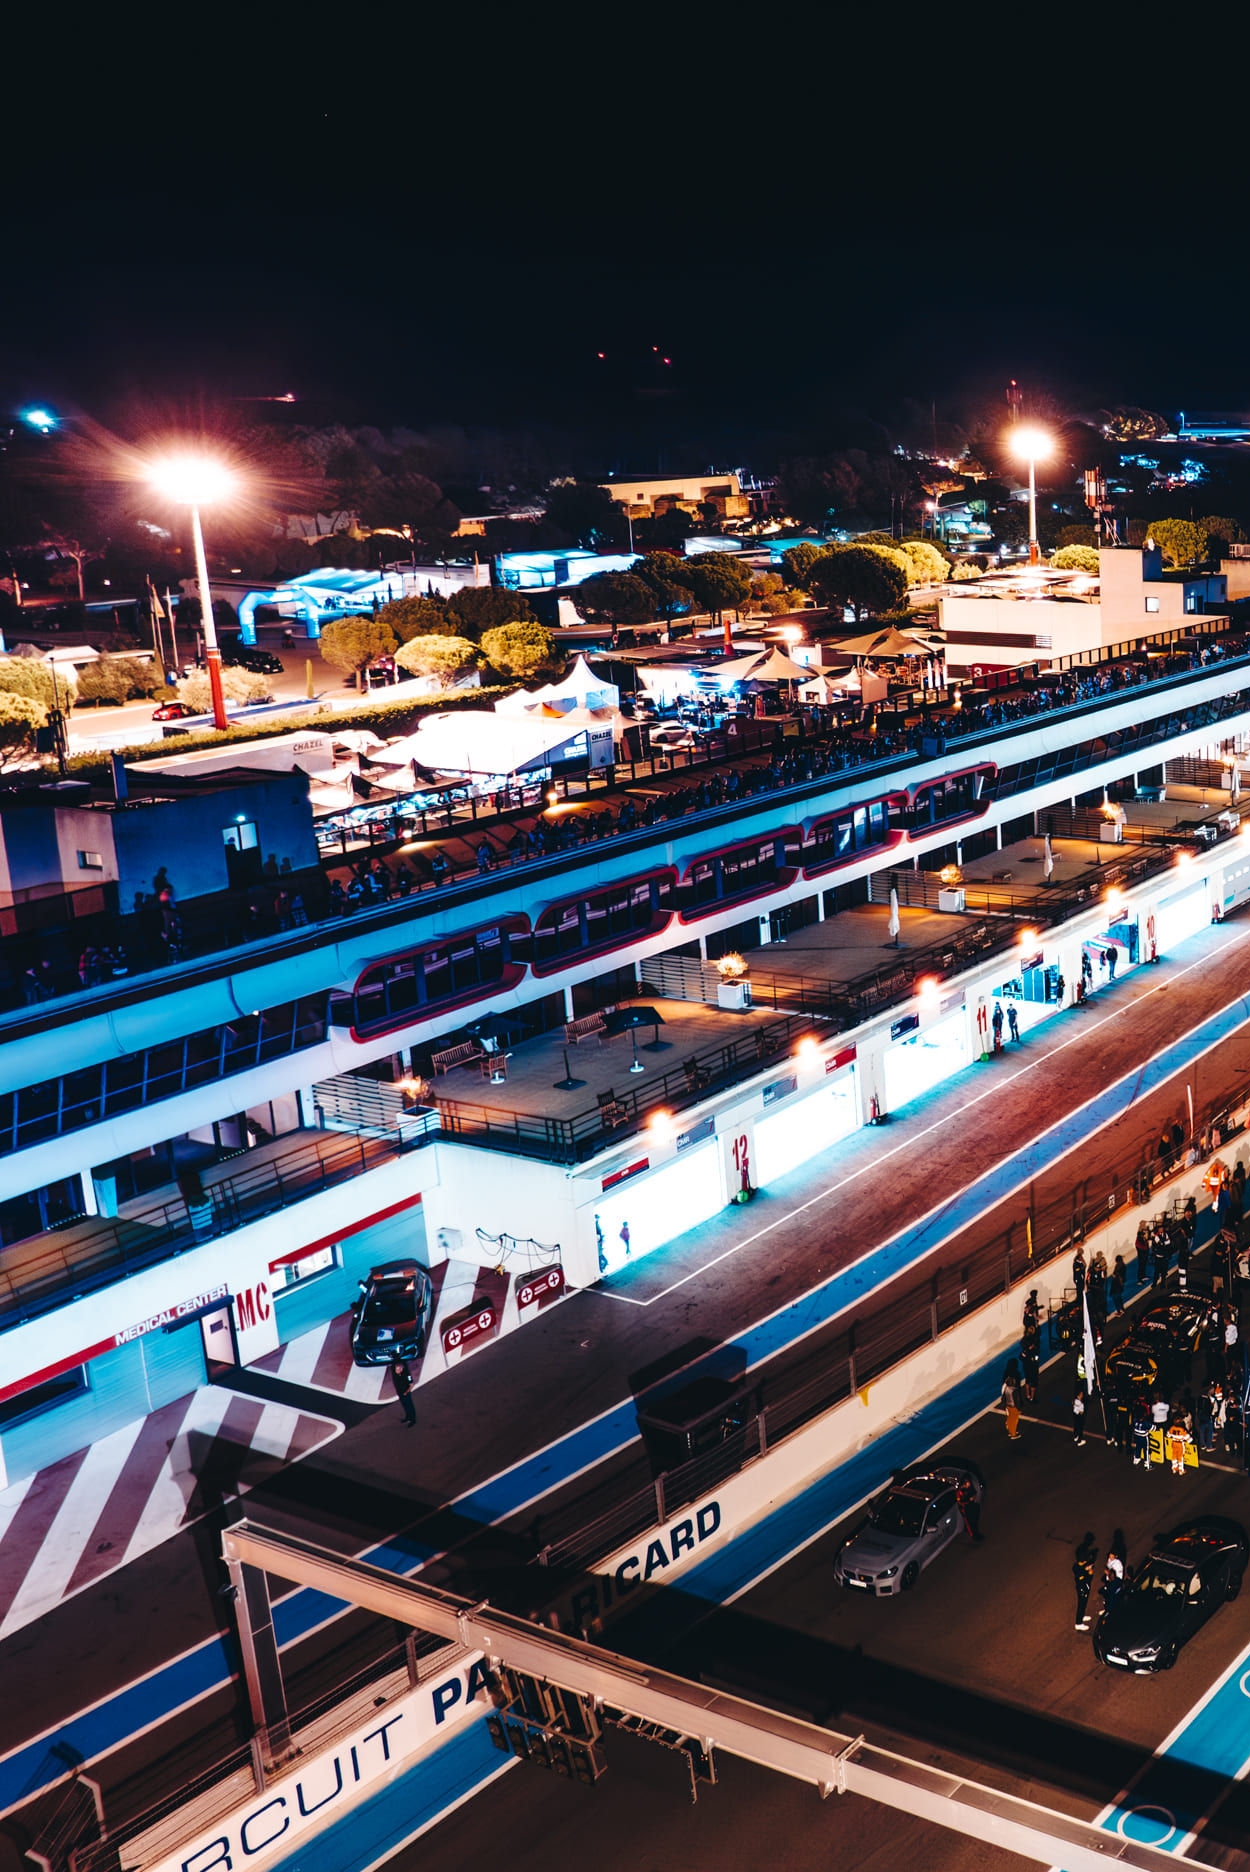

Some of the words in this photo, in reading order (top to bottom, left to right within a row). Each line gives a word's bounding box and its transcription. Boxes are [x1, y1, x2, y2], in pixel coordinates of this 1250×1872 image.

[973, 667, 982, 678] 3
[727, 723, 737, 735] 4
[1147, 915, 1154, 940] 10
[977, 1005, 987, 1034] 11
[677, 1136, 690, 1148] CMR
[732, 1134, 748, 1171] 12
[115, 1313, 175, 1346] MEDICAL
[176, 1284, 227, 1317] CENTER
[236, 1282, 270, 1331] MC
[571, 1501, 721, 1629] RICARD
